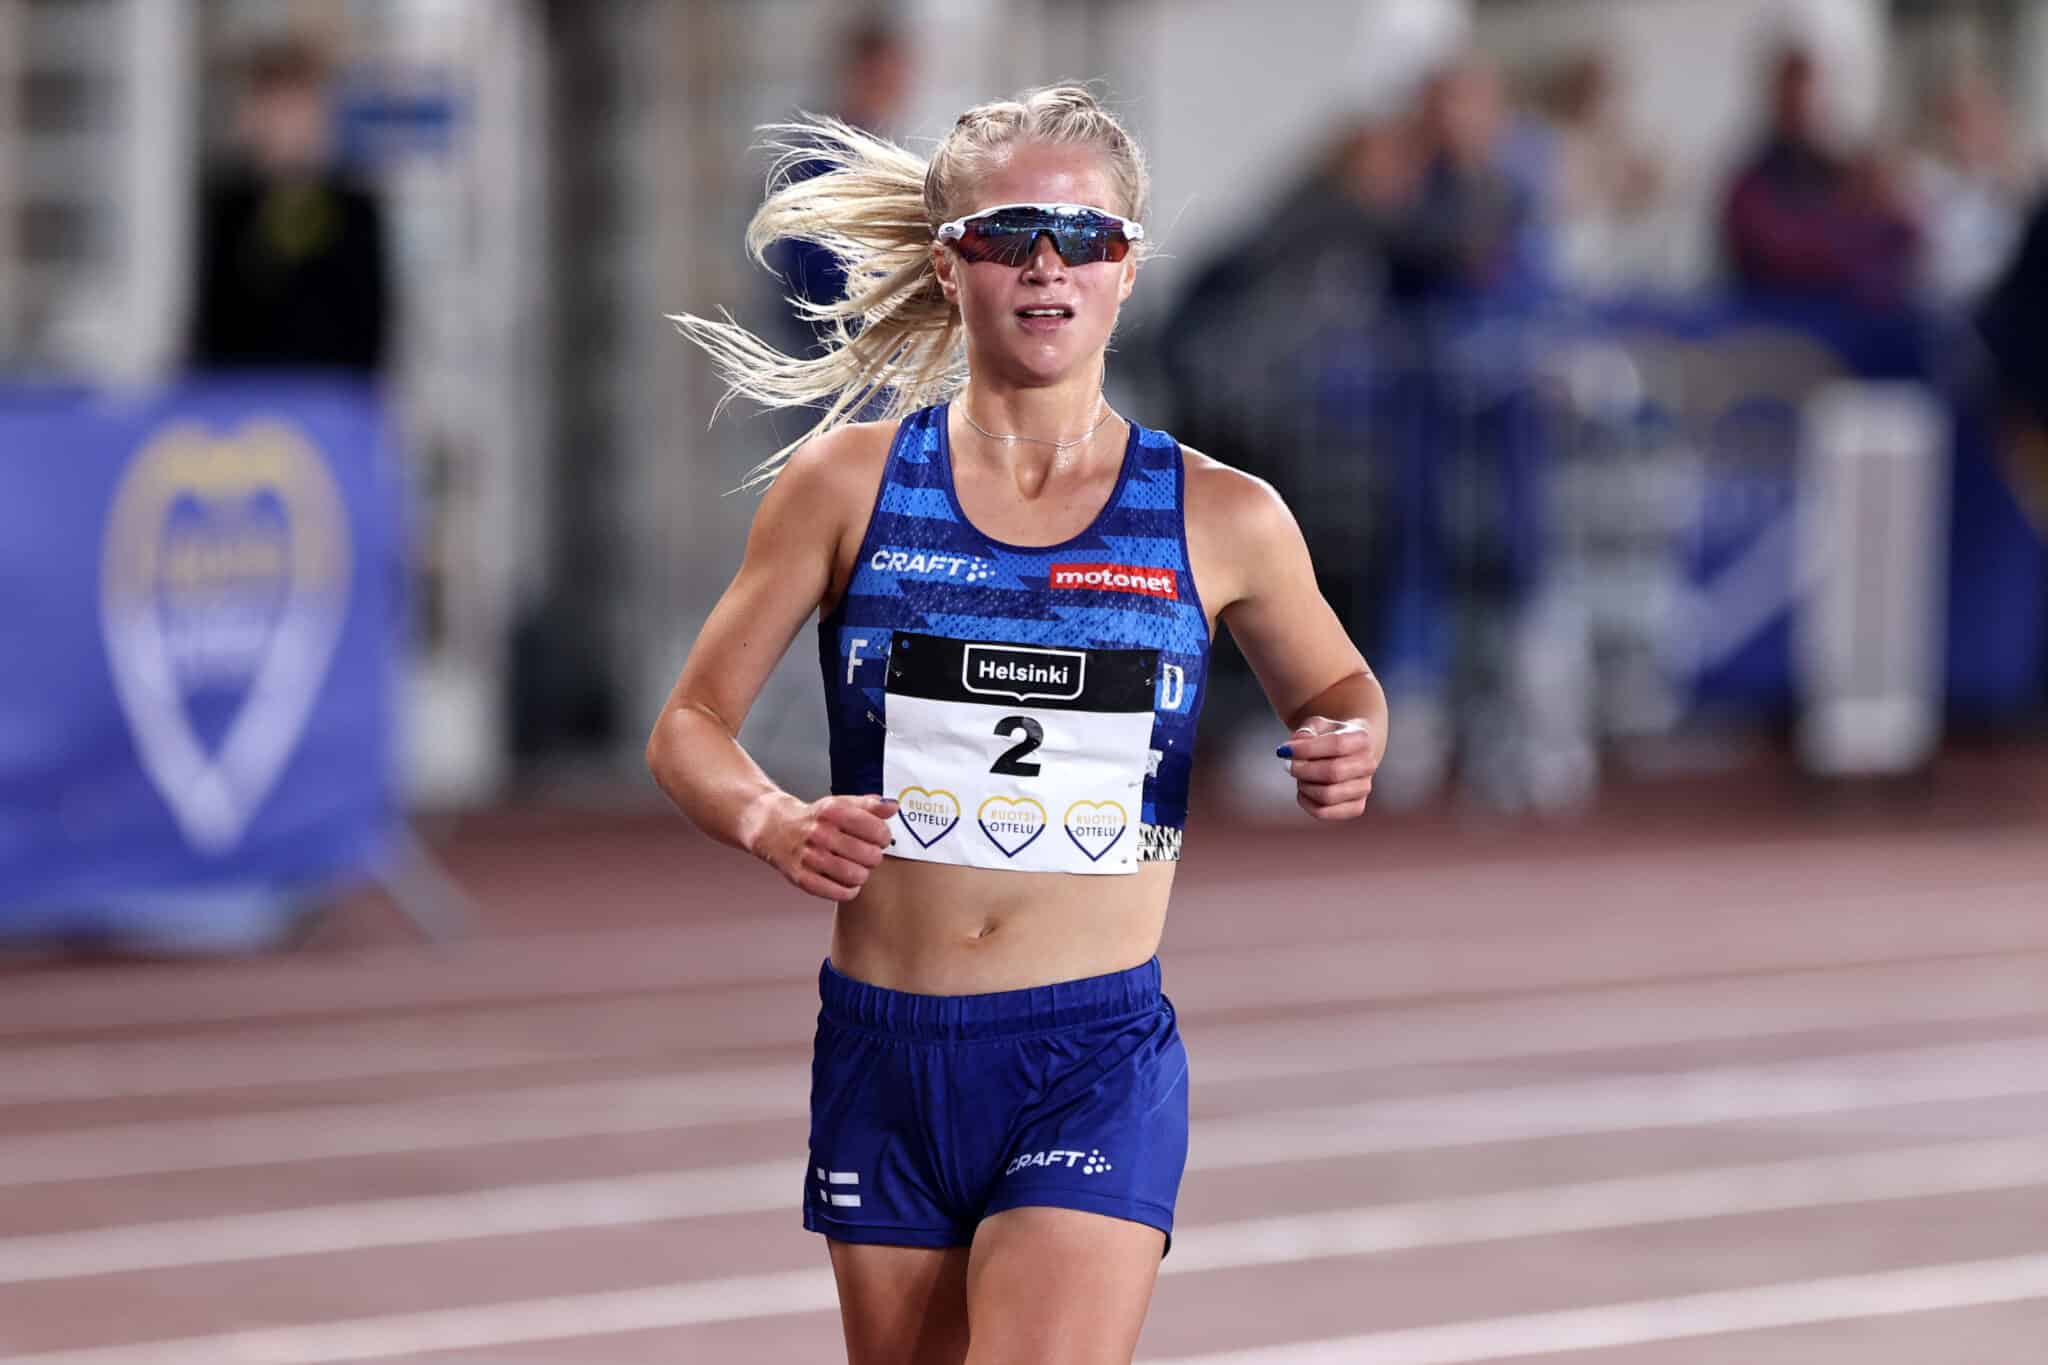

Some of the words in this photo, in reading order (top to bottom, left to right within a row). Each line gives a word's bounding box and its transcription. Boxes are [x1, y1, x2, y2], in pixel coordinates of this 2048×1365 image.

[871, 550, 967, 577] CRAFT
[1055, 571, 1172, 594] motonet
[979, 660, 1068, 685] Helsinki
[989, 716, 1044, 777] 2
[1005, 1150, 1085, 1176] CRAFT
